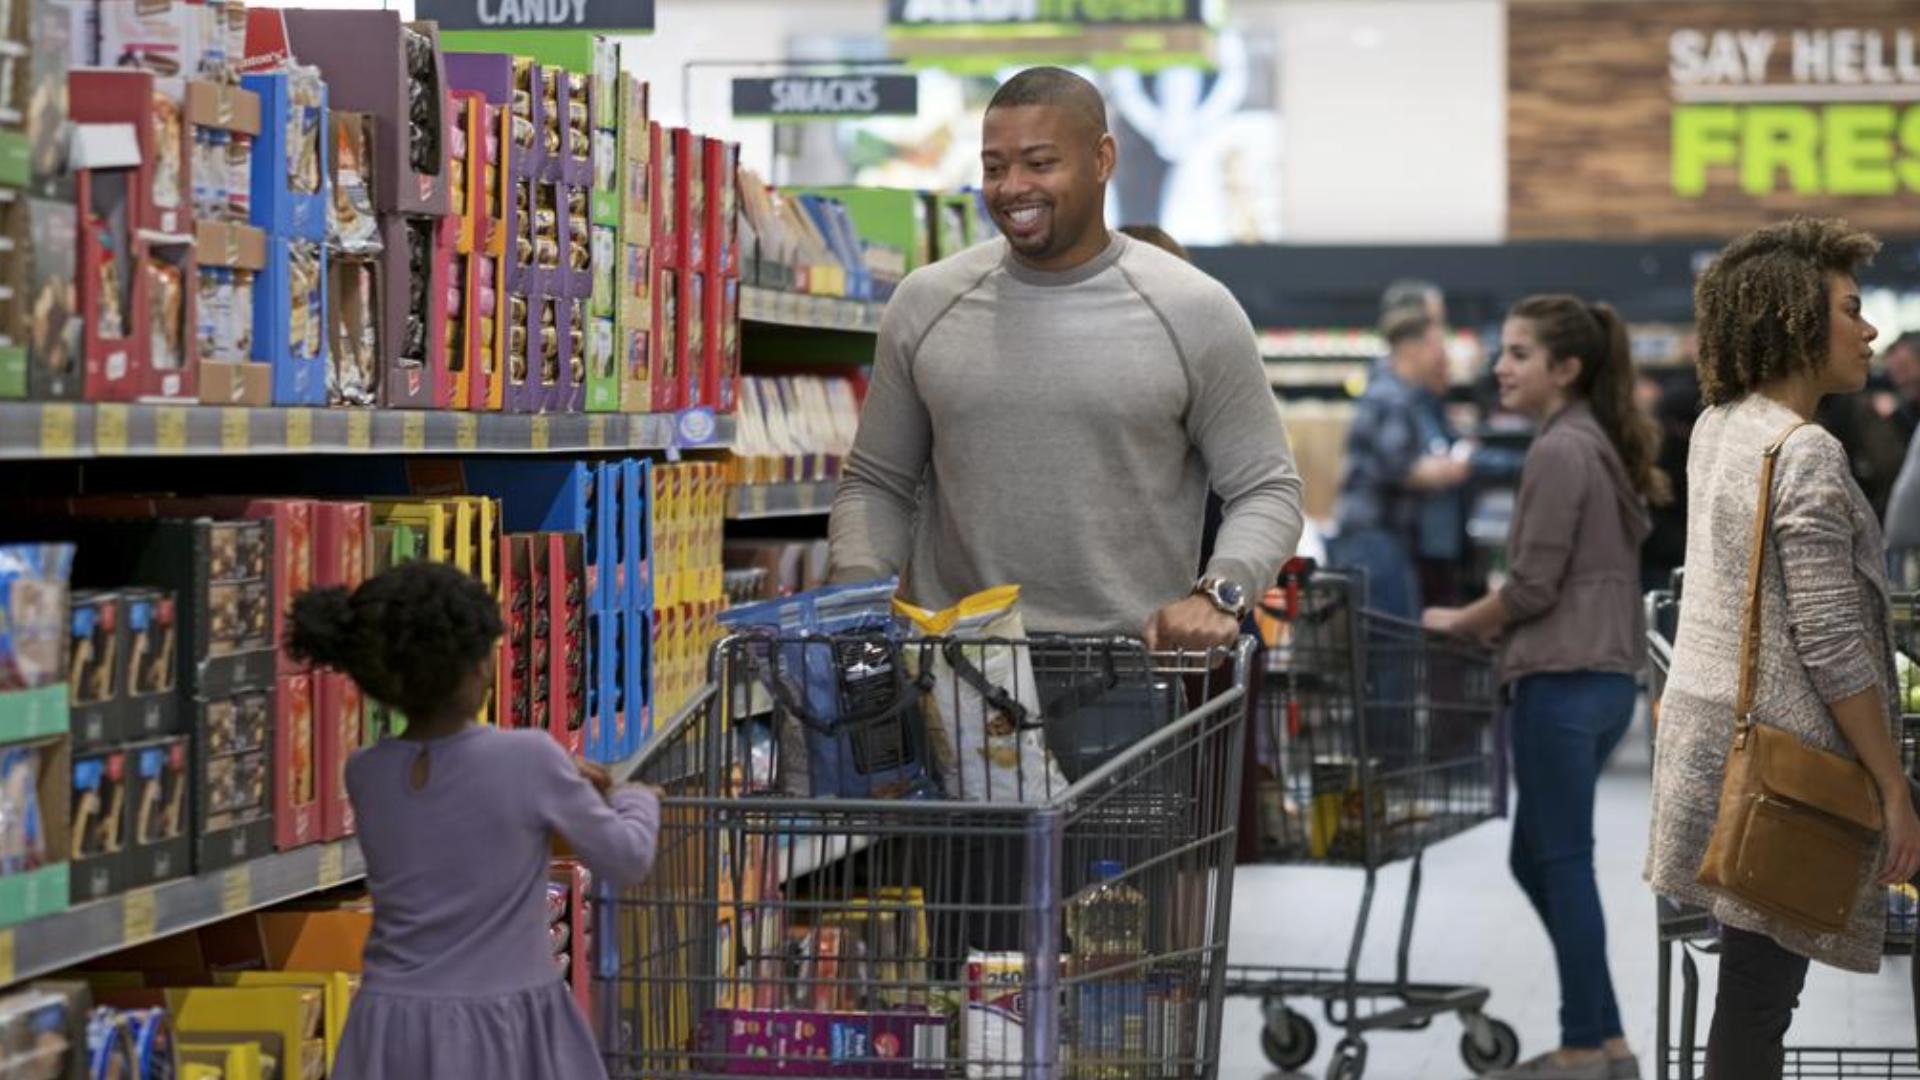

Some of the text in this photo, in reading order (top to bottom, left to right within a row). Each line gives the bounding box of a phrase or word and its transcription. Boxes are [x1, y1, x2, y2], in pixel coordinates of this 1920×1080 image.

[477, 0, 587, 24] CANDY
[1668, 28, 1776, 84] SAY
[770, 78, 879, 112] SNACKS
